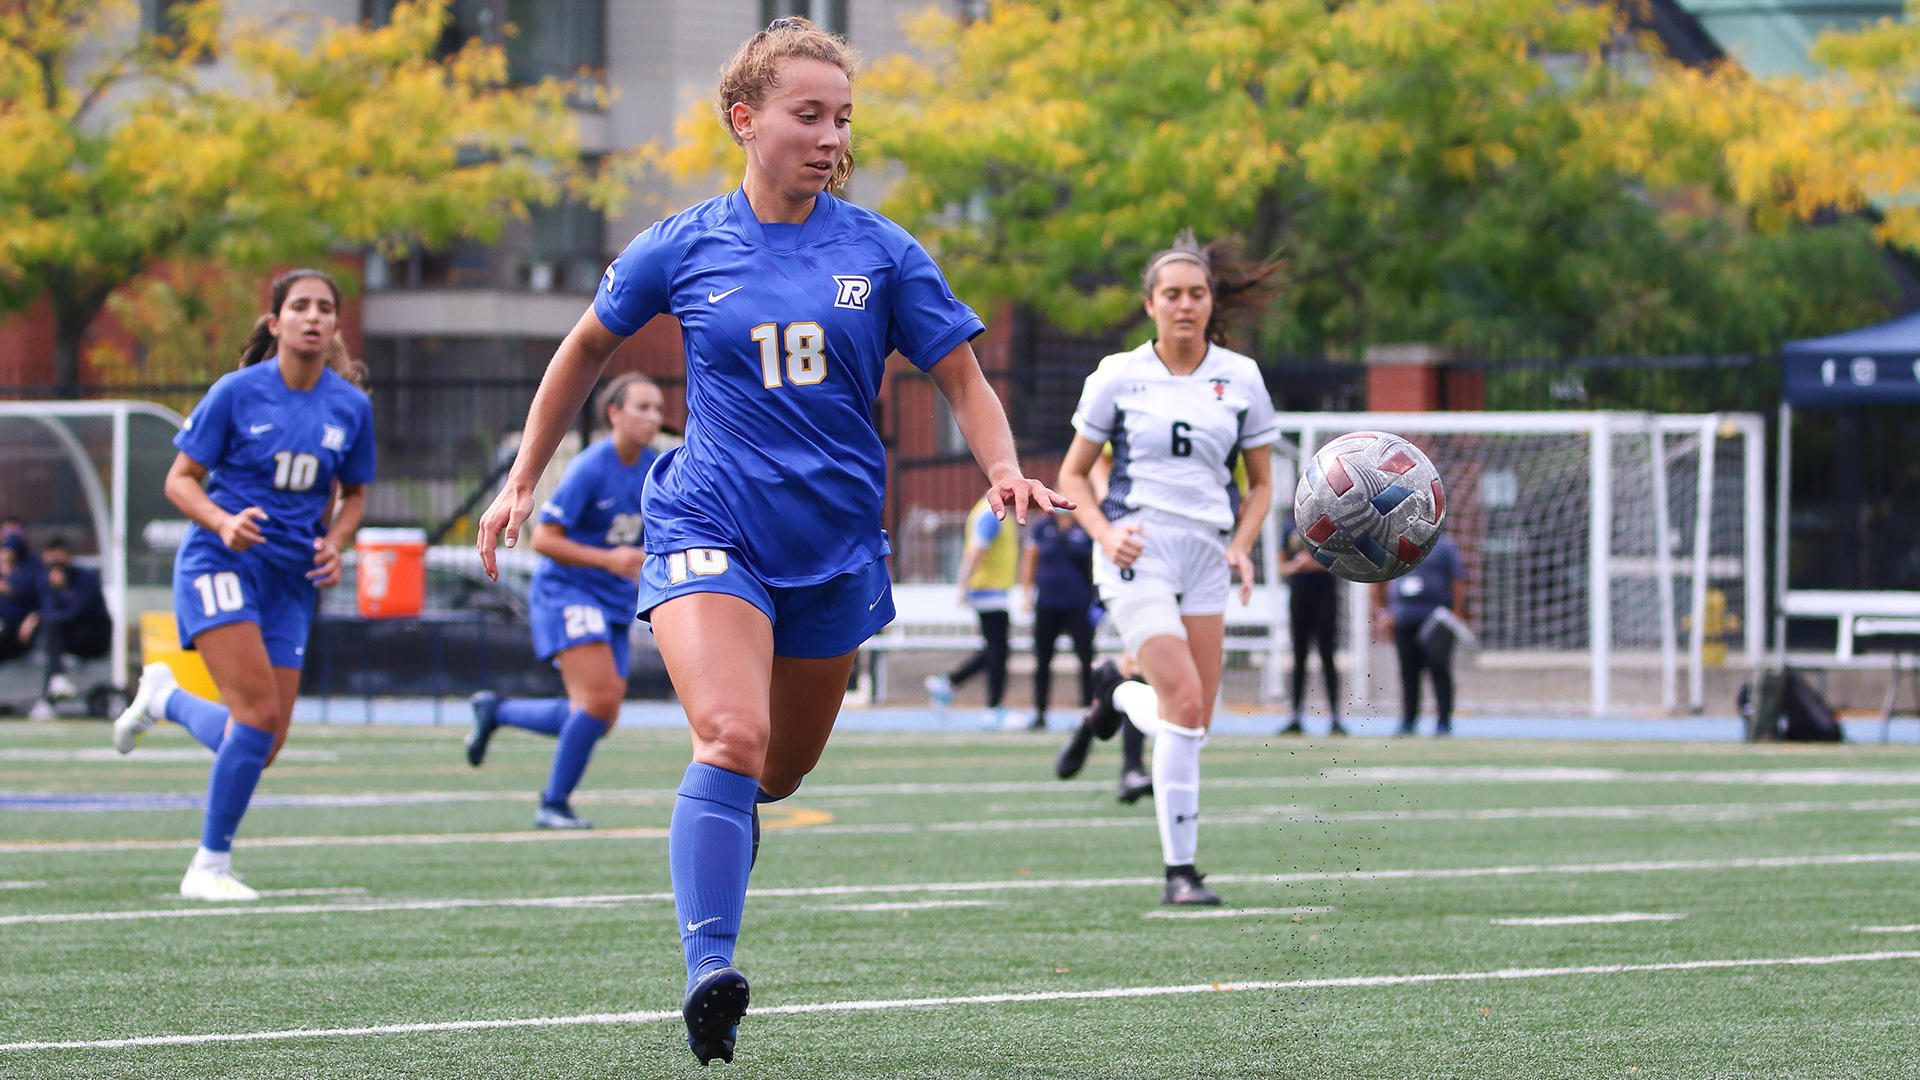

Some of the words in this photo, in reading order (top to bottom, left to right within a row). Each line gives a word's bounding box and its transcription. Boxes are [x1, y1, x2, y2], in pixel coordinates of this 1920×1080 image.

[831, 275, 872, 310] R
[750, 321, 828, 389] 18
[1171, 420, 1193, 457] 6
[273, 450, 319, 492] 10
[194, 571, 244, 617] 10
